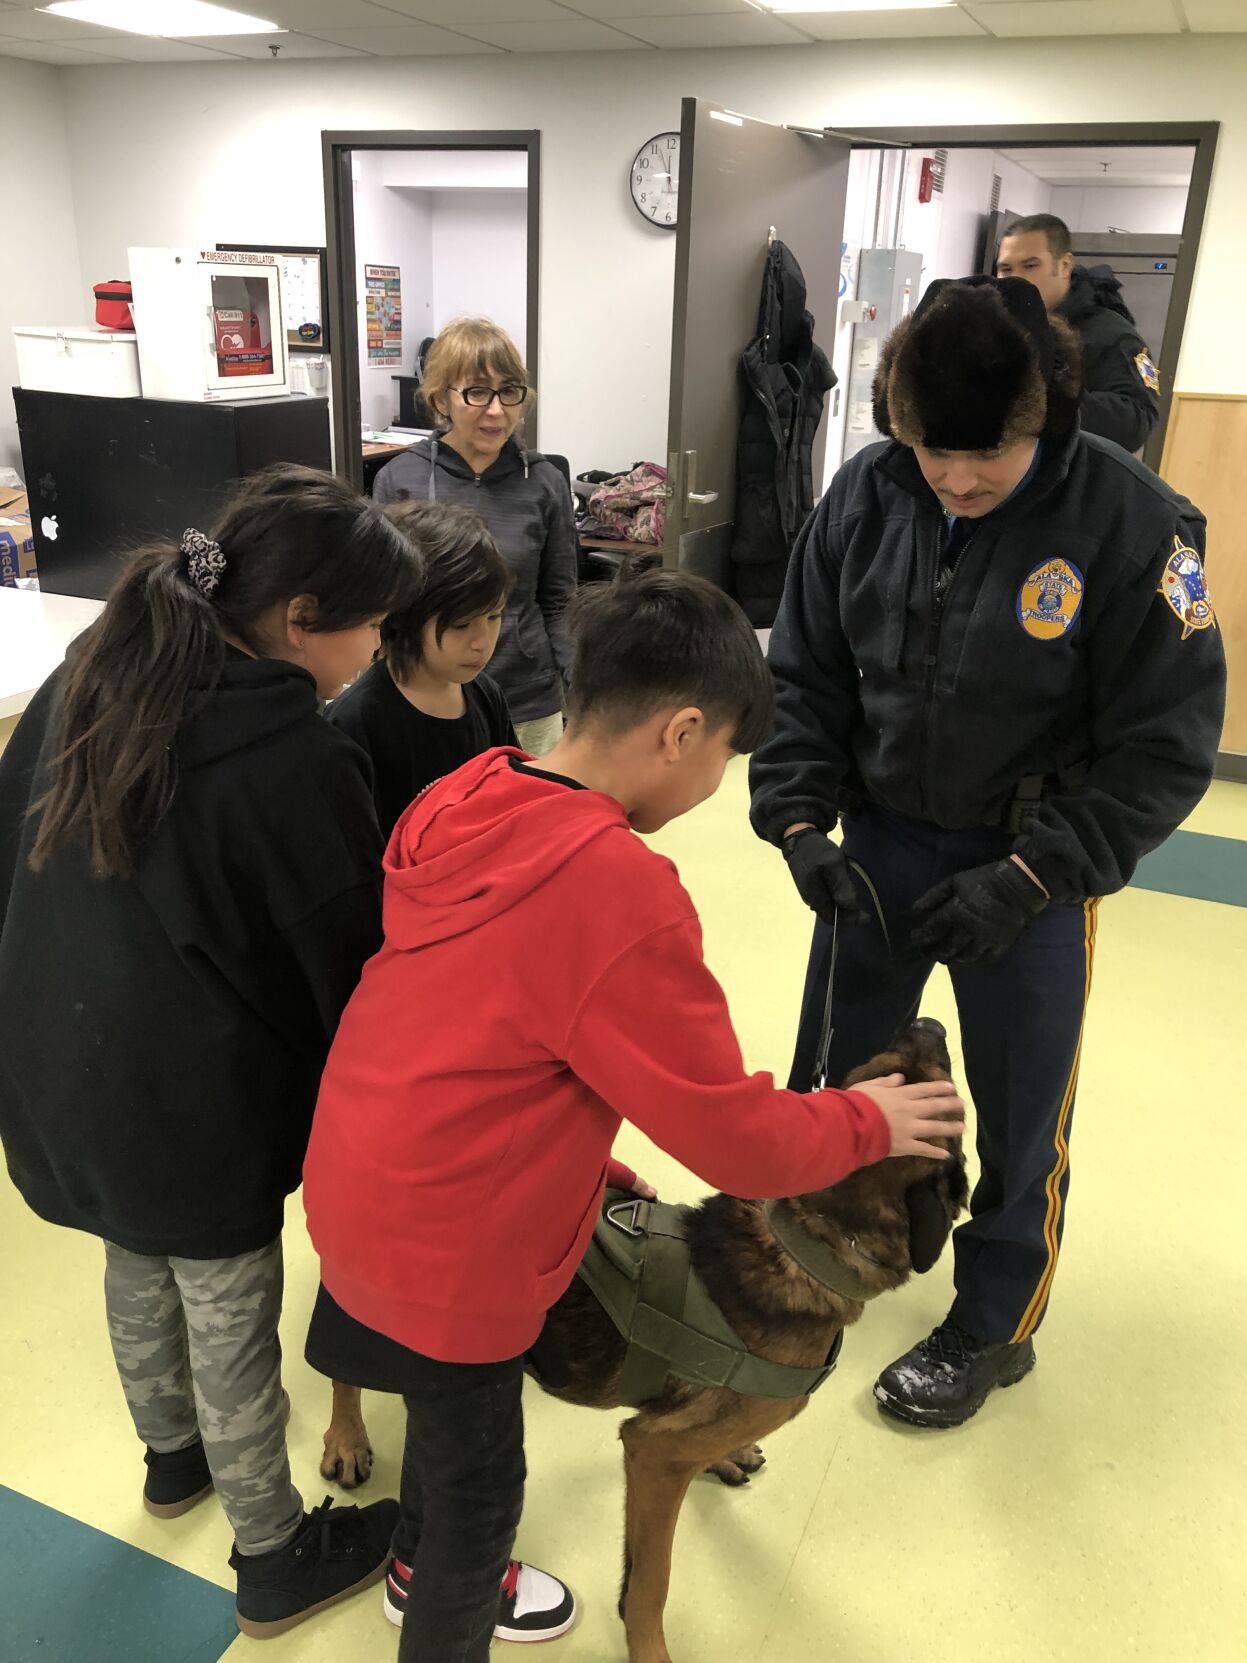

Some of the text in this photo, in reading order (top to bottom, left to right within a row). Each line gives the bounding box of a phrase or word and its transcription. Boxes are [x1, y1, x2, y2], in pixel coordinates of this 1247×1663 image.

[651, 144, 658, 154] 11
[667, 139, 676, 149] 12
[639, 158, 649, 168] 10
[636, 175, 642, 185] 9
[640, 193, 646, 203] 8
[651, 206, 657, 216] 7
[665, 212, 671, 221] 6
[206, 251, 275, 264] EMERGENCY DEFIBRILLATOR
[1173, 551, 1197, 567] ALASKA
[1044, 582, 1065, 593] STATE
[1029, 610, 1066, 622] TROOPERS
